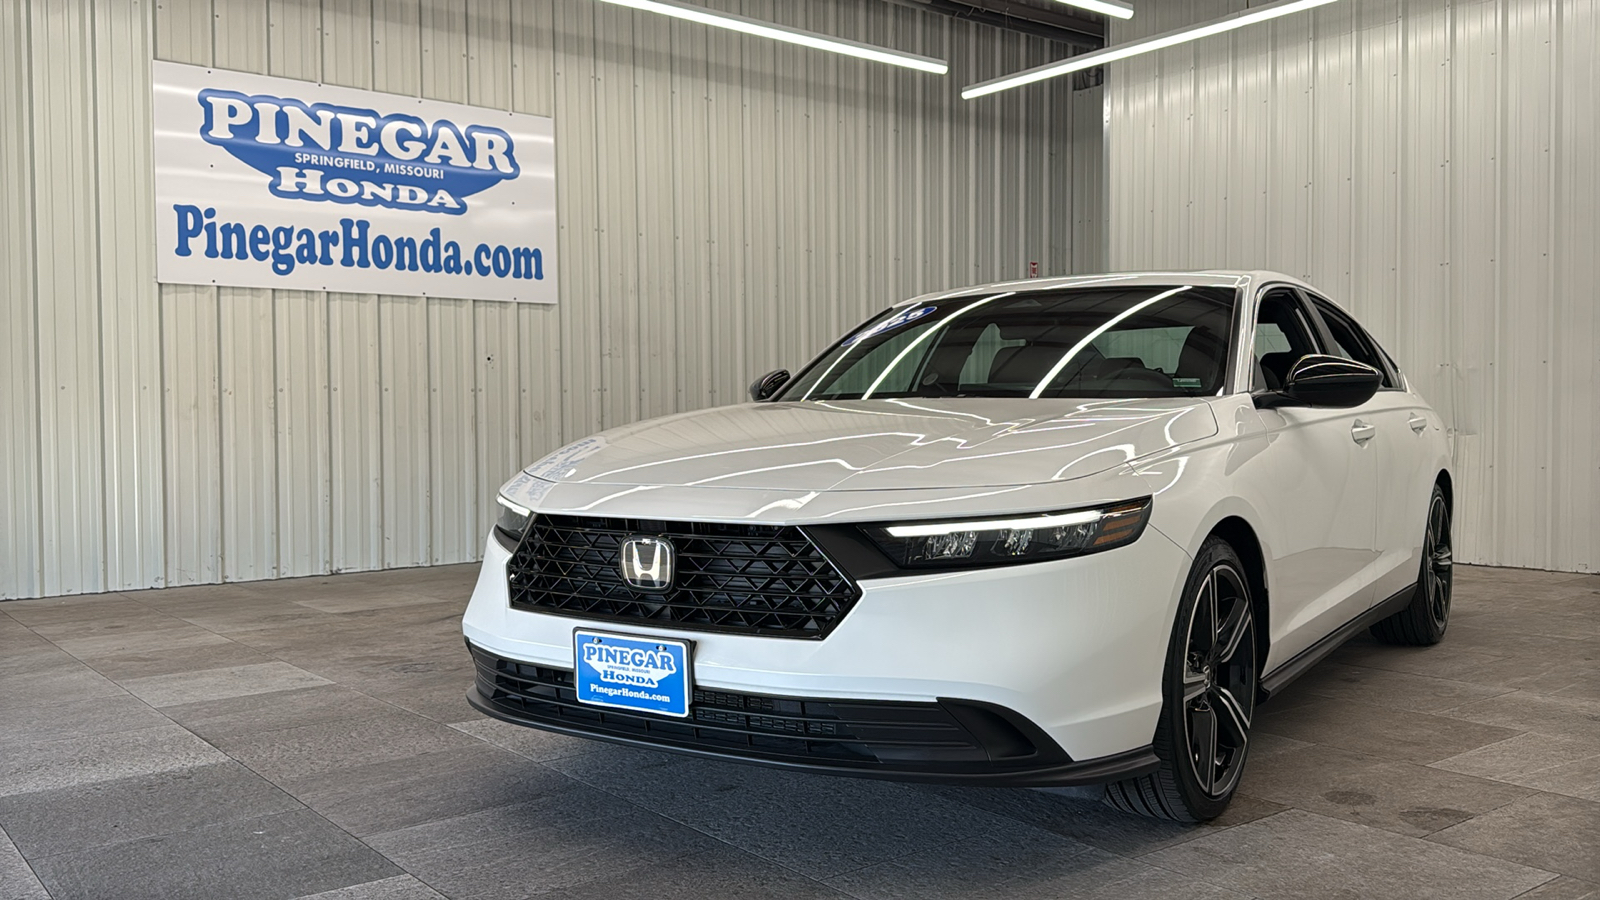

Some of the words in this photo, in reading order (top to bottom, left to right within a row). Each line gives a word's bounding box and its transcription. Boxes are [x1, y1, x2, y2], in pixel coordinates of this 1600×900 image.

[206, 96, 514, 174] PINEGAR
[294, 152, 381, 174] SPRINGFIELD,
[384, 163, 444, 180] MISSOURI
[276, 166, 462, 209] HONDA
[173, 203, 543, 280] PinegarHonda.com
[585, 645, 674, 671] PINEGAR
[602, 669, 656, 686] HONDA
[590, 683, 670, 703] PinegarHonda.com
